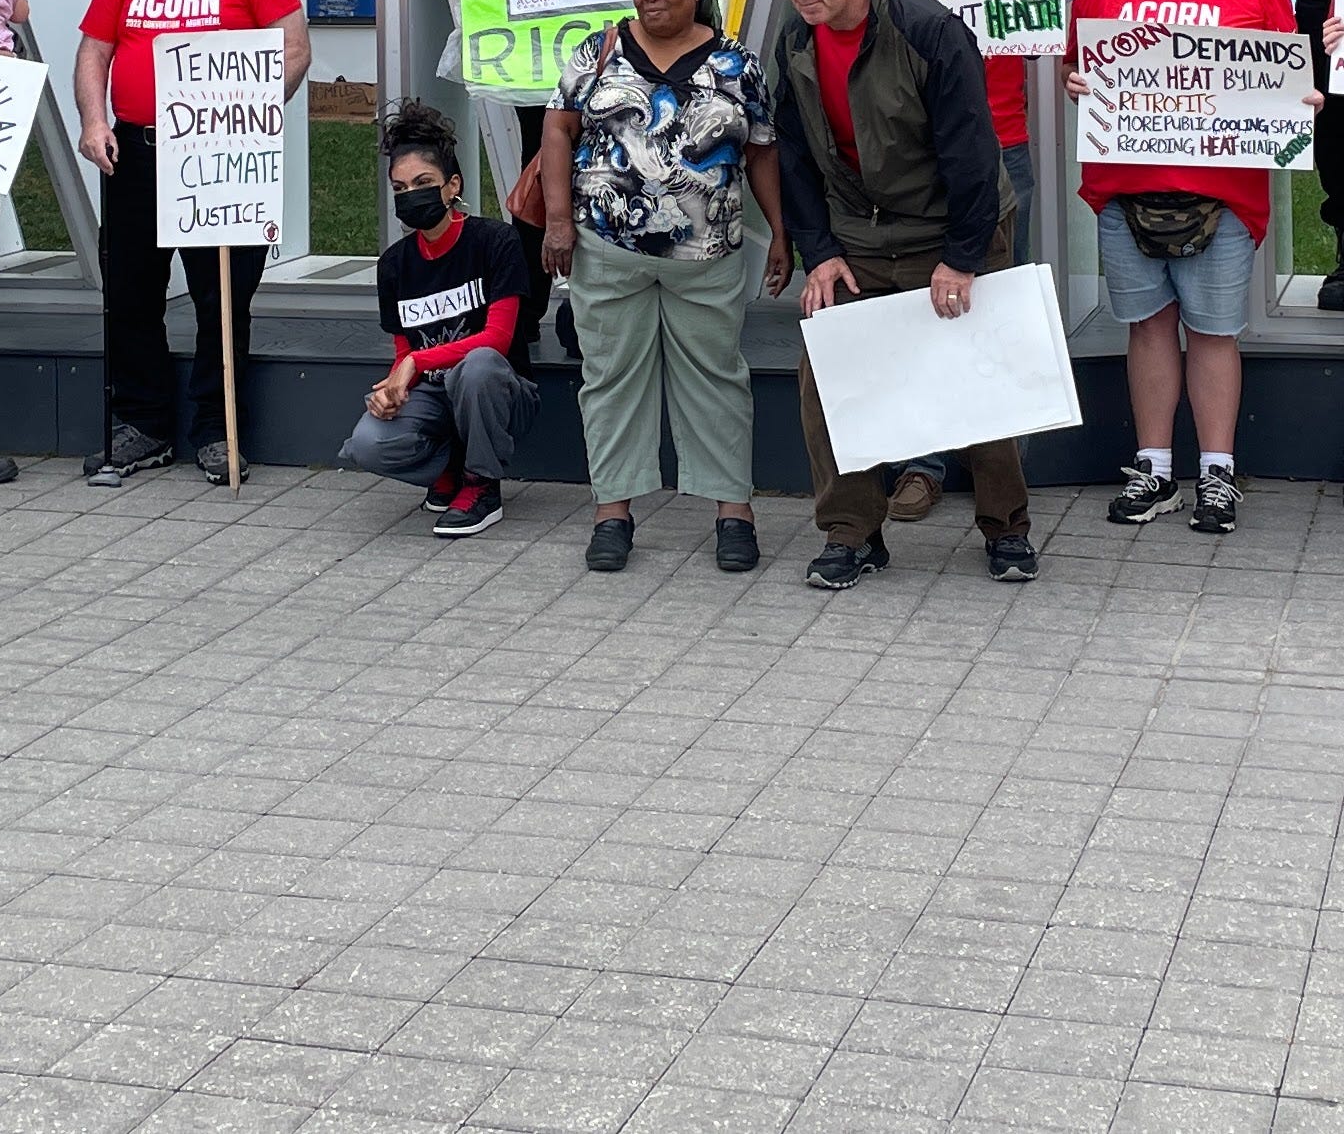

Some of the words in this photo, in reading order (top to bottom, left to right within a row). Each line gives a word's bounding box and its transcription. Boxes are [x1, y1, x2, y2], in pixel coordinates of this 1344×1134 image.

[165, 43, 283, 83] TENANTS
[468, 16, 635, 84] RIG
[1172, 32, 1306, 70] DEMANDS
[1118, 67, 1160, 89] MAX
[1166, 65, 1214, 91] HEAT
[1223, 69, 1285, 91] BYLAW
[166, 101, 284, 140] DEMAND
[1118, 91, 1217, 115] RETROFITS
[1117, 114, 1163, 132] MORE
[1164, 115, 1212, 132] PUBLIC
[1212, 117, 1269, 134] COOLING
[1270, 119, 1313, 136] SPACES
[1117, 134, 1195, 156] RECORDING
[180, 150, 282, 188] CLIMATE
[176, 195, 266, 233] JUSTICE
[401, 288, 468, 323] ISAIAH
